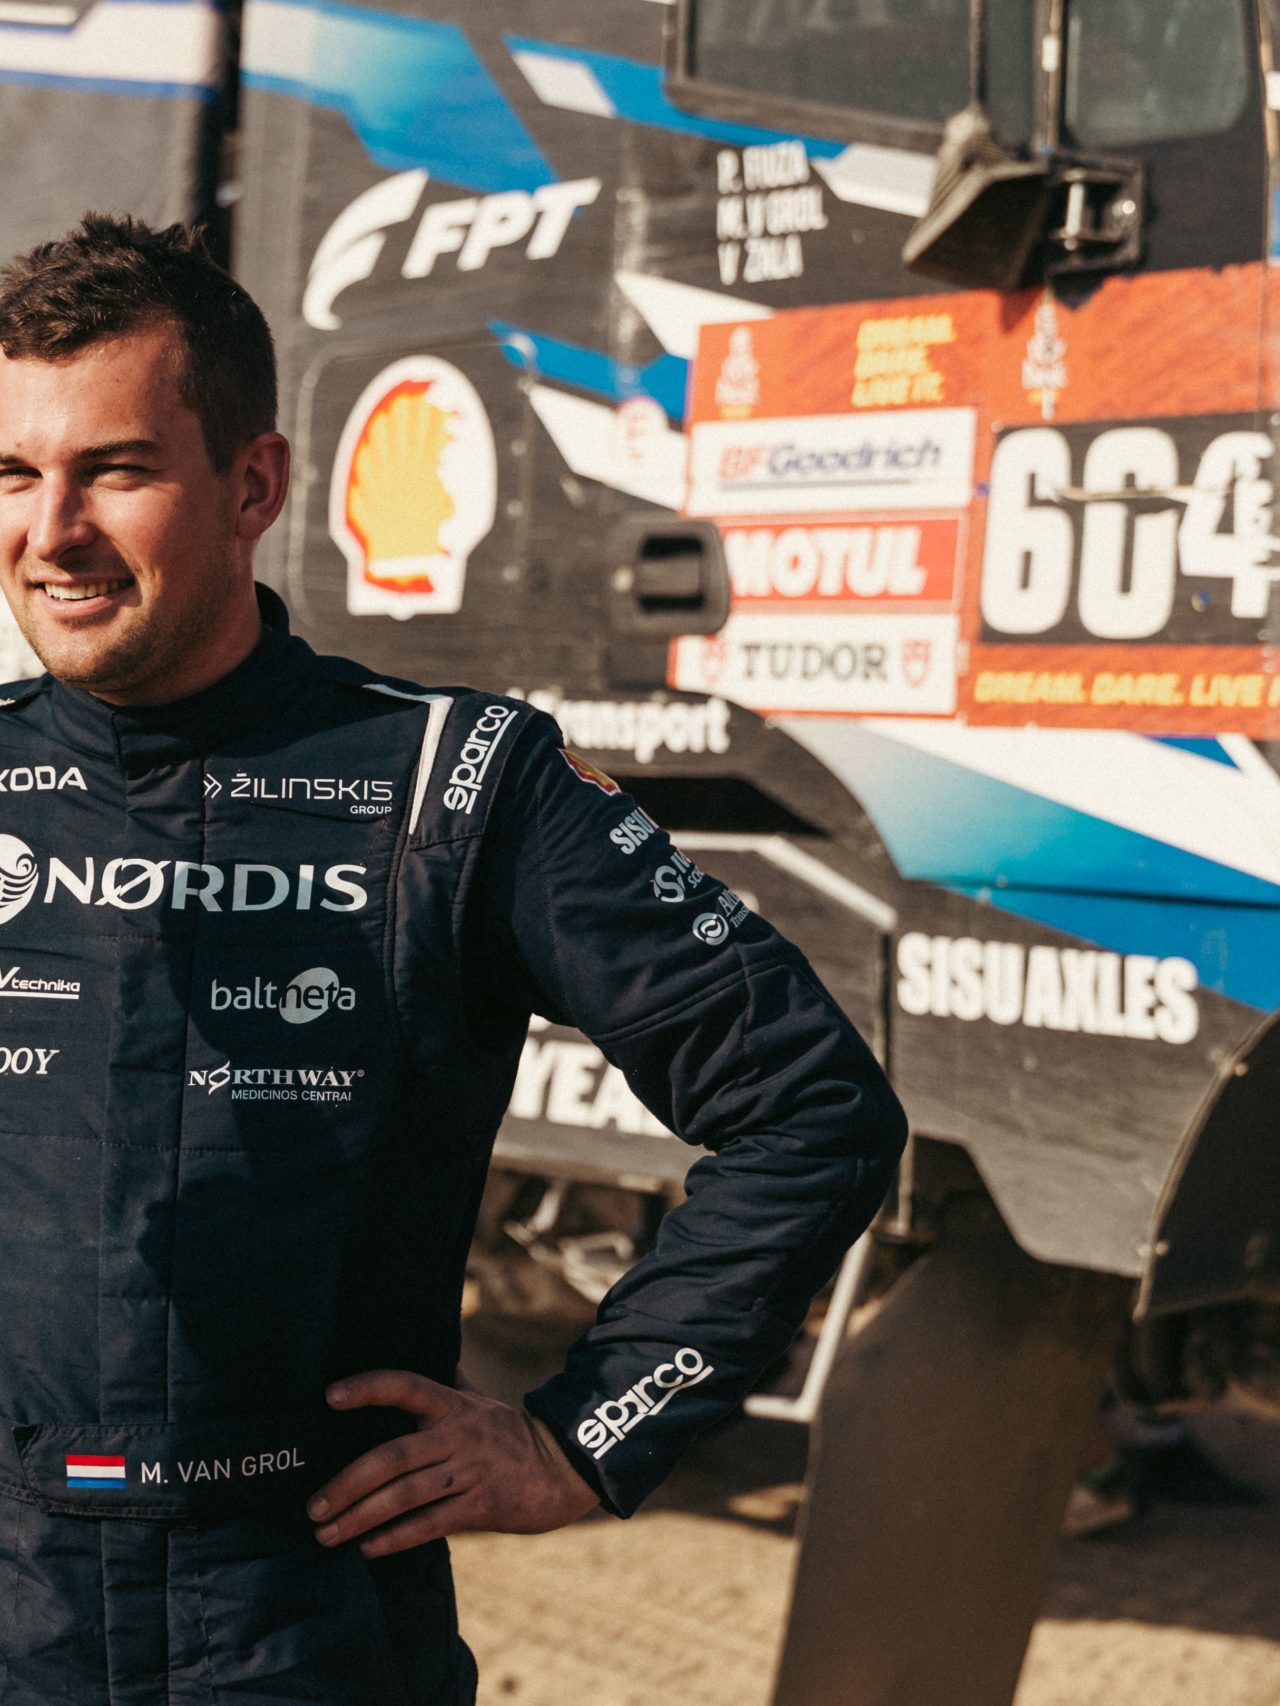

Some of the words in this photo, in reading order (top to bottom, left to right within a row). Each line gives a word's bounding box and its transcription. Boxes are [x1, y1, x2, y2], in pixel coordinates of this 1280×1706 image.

[401, 176, 602, 279] FPT
[727, 526, 927, 597] MOTUL
[980, 426, 1274, 640] 604
[741, 643, 888, 681] TUDOR
[443, 705, 515, 814] sparco
[349, 805, 393, 815] GROUP
[43, 857, 369, 912] NØRDIS
[210, 976, 356, 1012] baltneta
[231, 1089, 298, 1100] MEDICINOS
[301, 1090, 352, 1102] CENTRAI
[509, 1037, 670, 1138] YEA
[576, 1346, 714, 1460] sparco
[141, 1461, 168, 1484] M.
[177, 1458, 231, 1483] VAN
[241, 1447, 305, 1477] GROL
